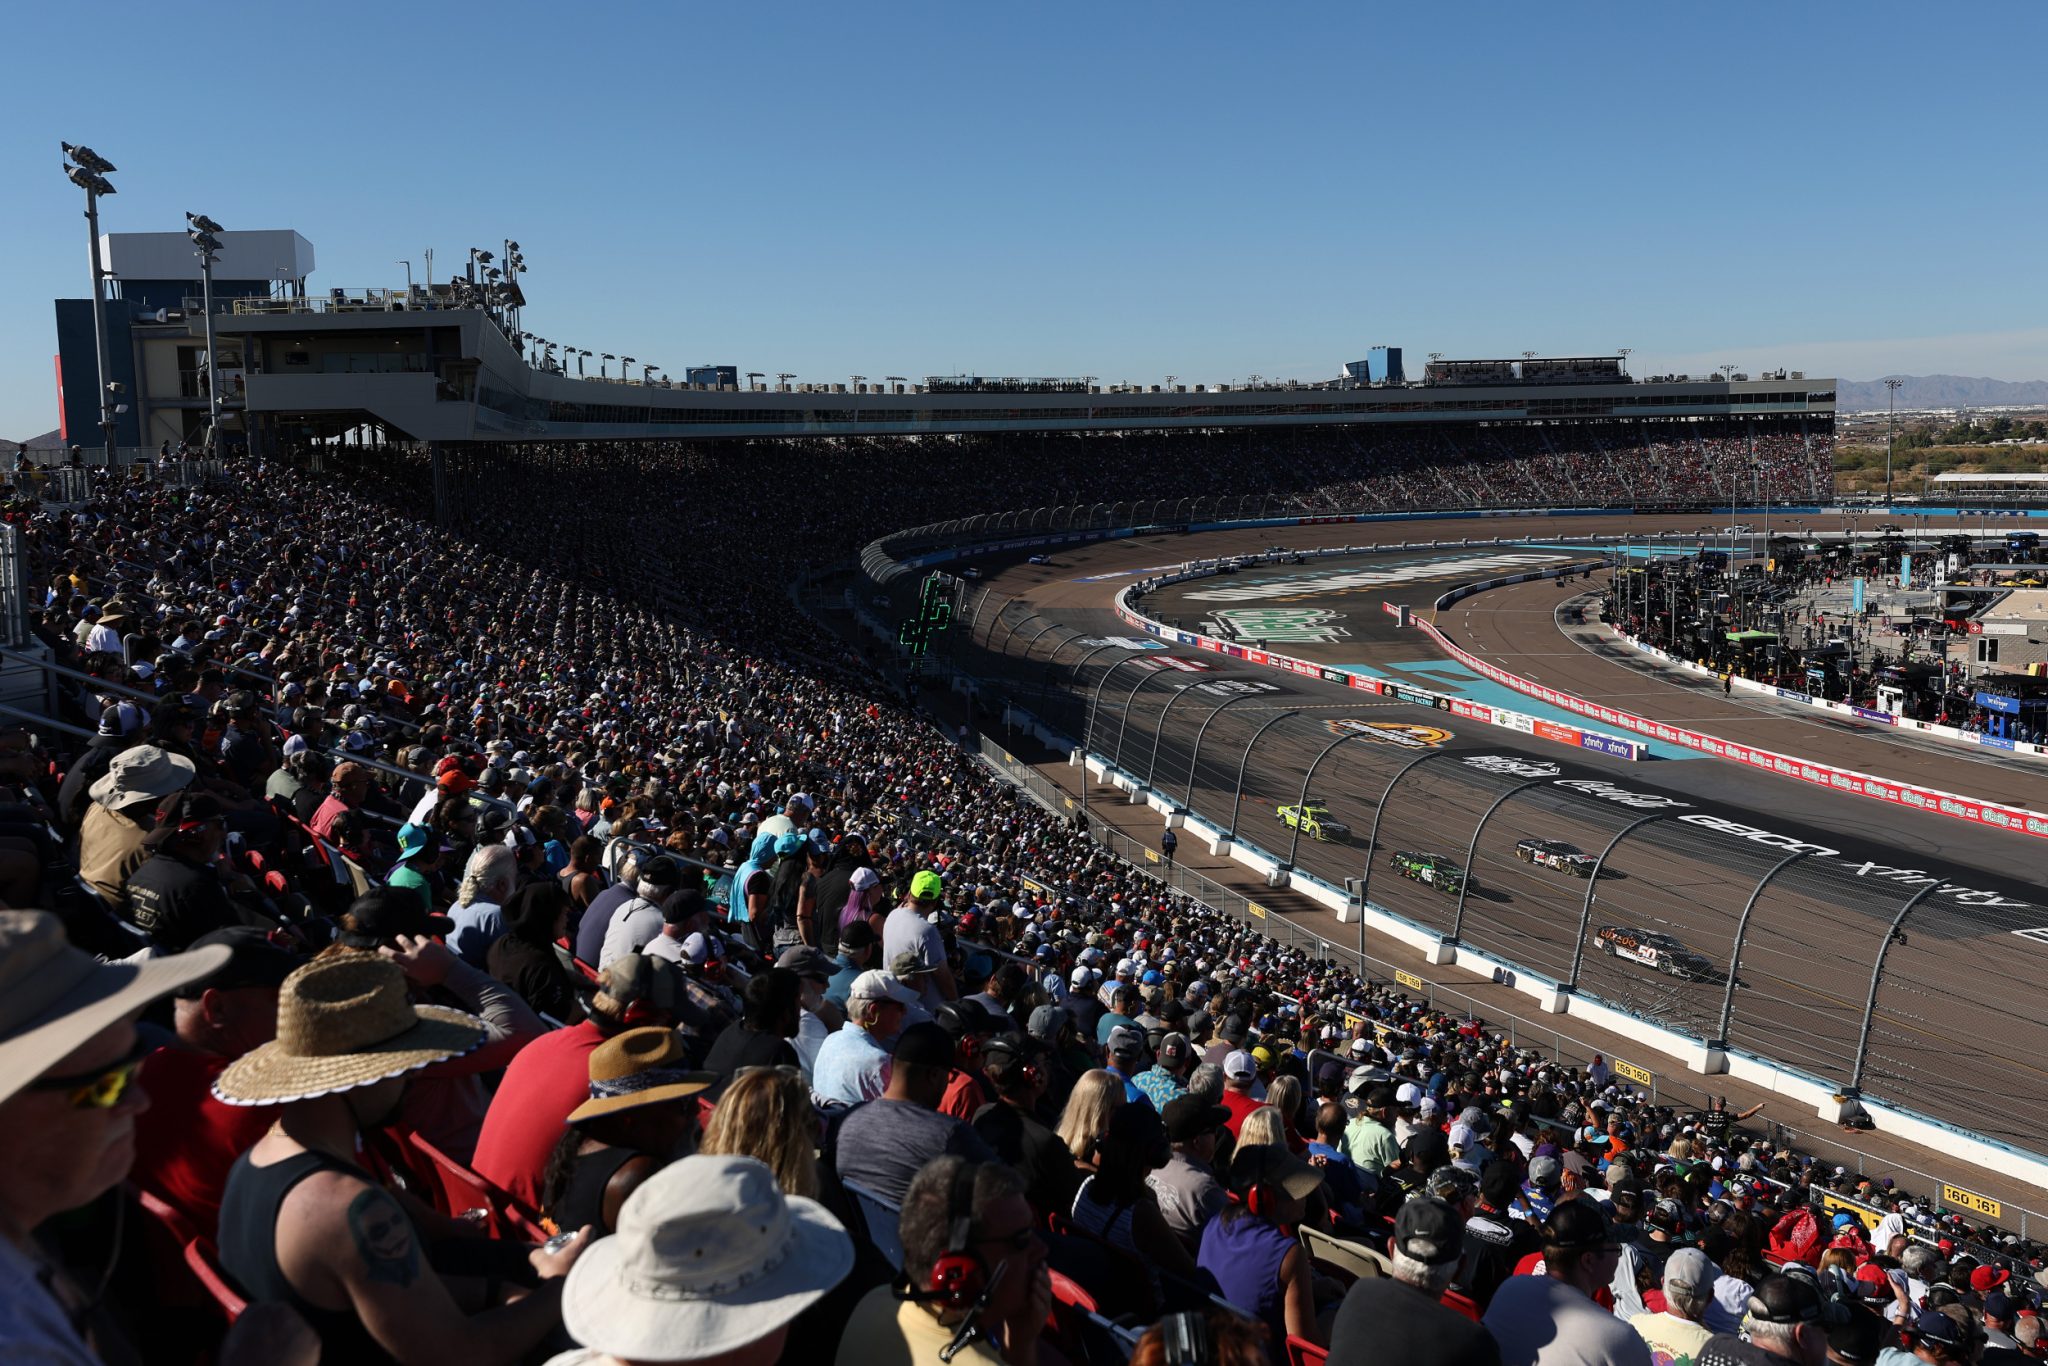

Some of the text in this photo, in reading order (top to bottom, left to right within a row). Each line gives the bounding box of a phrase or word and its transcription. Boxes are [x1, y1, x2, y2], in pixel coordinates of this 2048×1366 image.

[1398, 692, 1414, 702] PHOENIX
[1415, 696, 1433, 706] RACEWAY
[1584, 736, 1604, 750] xfinity
[1607, 742, 1629, 756] xfinity
[1677, 815, 1841, 856] GEICO
[1548, 855, 1558, 866] 15
[1840, 861, 2032, 907] xfinity
[1638, 945, 1657, 960] 50
[1397, 972, 1420, 988] 158 159
[1616, 1062, 1648, 1082] 159 160
[1946, 1188, 1996, 1215] 160 161
